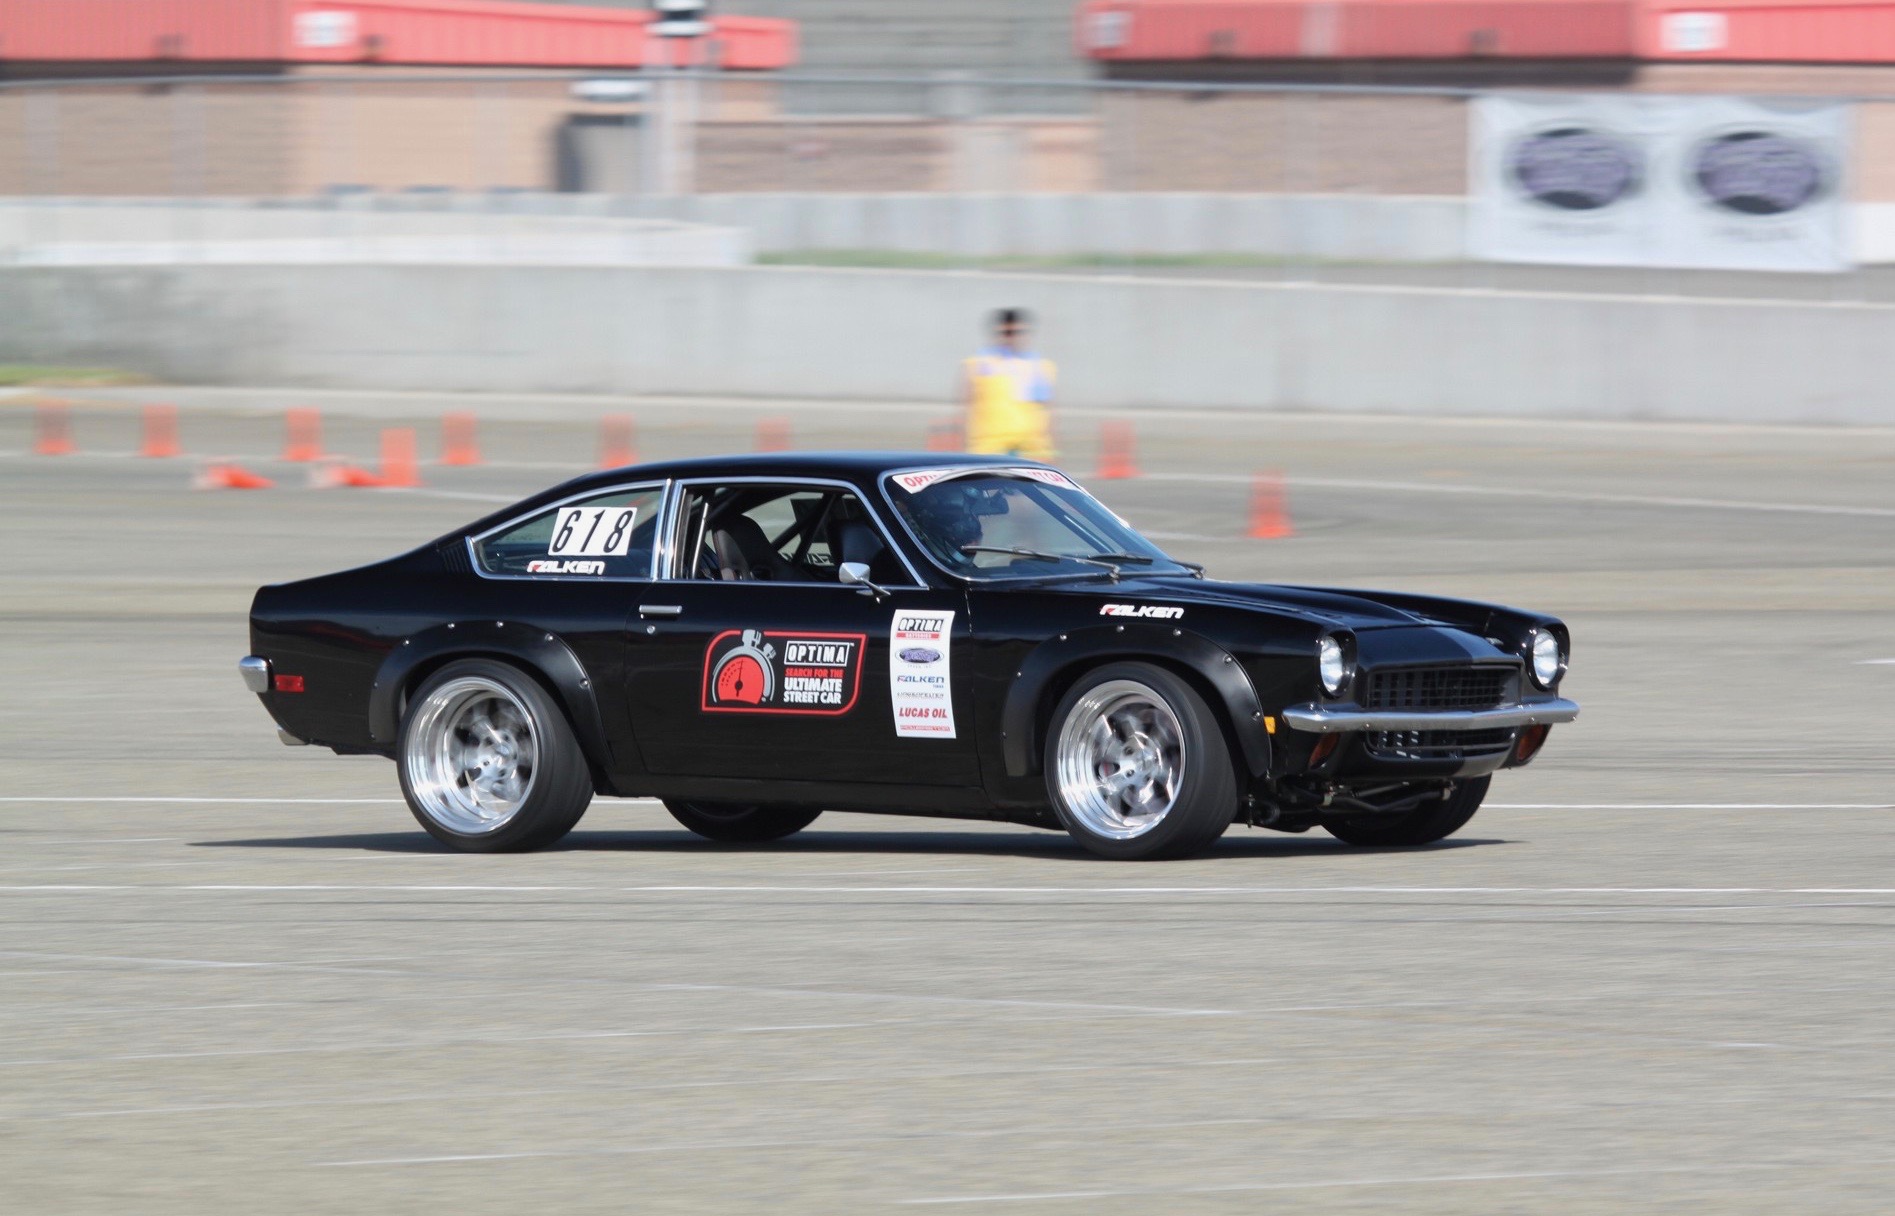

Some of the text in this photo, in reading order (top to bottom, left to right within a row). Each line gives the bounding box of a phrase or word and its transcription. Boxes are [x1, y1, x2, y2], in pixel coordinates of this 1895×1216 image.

[552, 510, 633, 553] 618
[527, 560, 605, 575] FALKEN
[1100, 604, 1184, 619] FALKEN
[899, 618, 943, 632] OPTIMA
[788, 644, 845, 663] OPTIMA
[785, 667, 844, 679] SEARCH FOR THE
[897, 675, 945, 684] FALKEN
[784, 676, 843, 693] ULTIMATE
[783, 690, 842, 705] STREET CAR
[899, 707, 948, 719] LUCAS OIL
